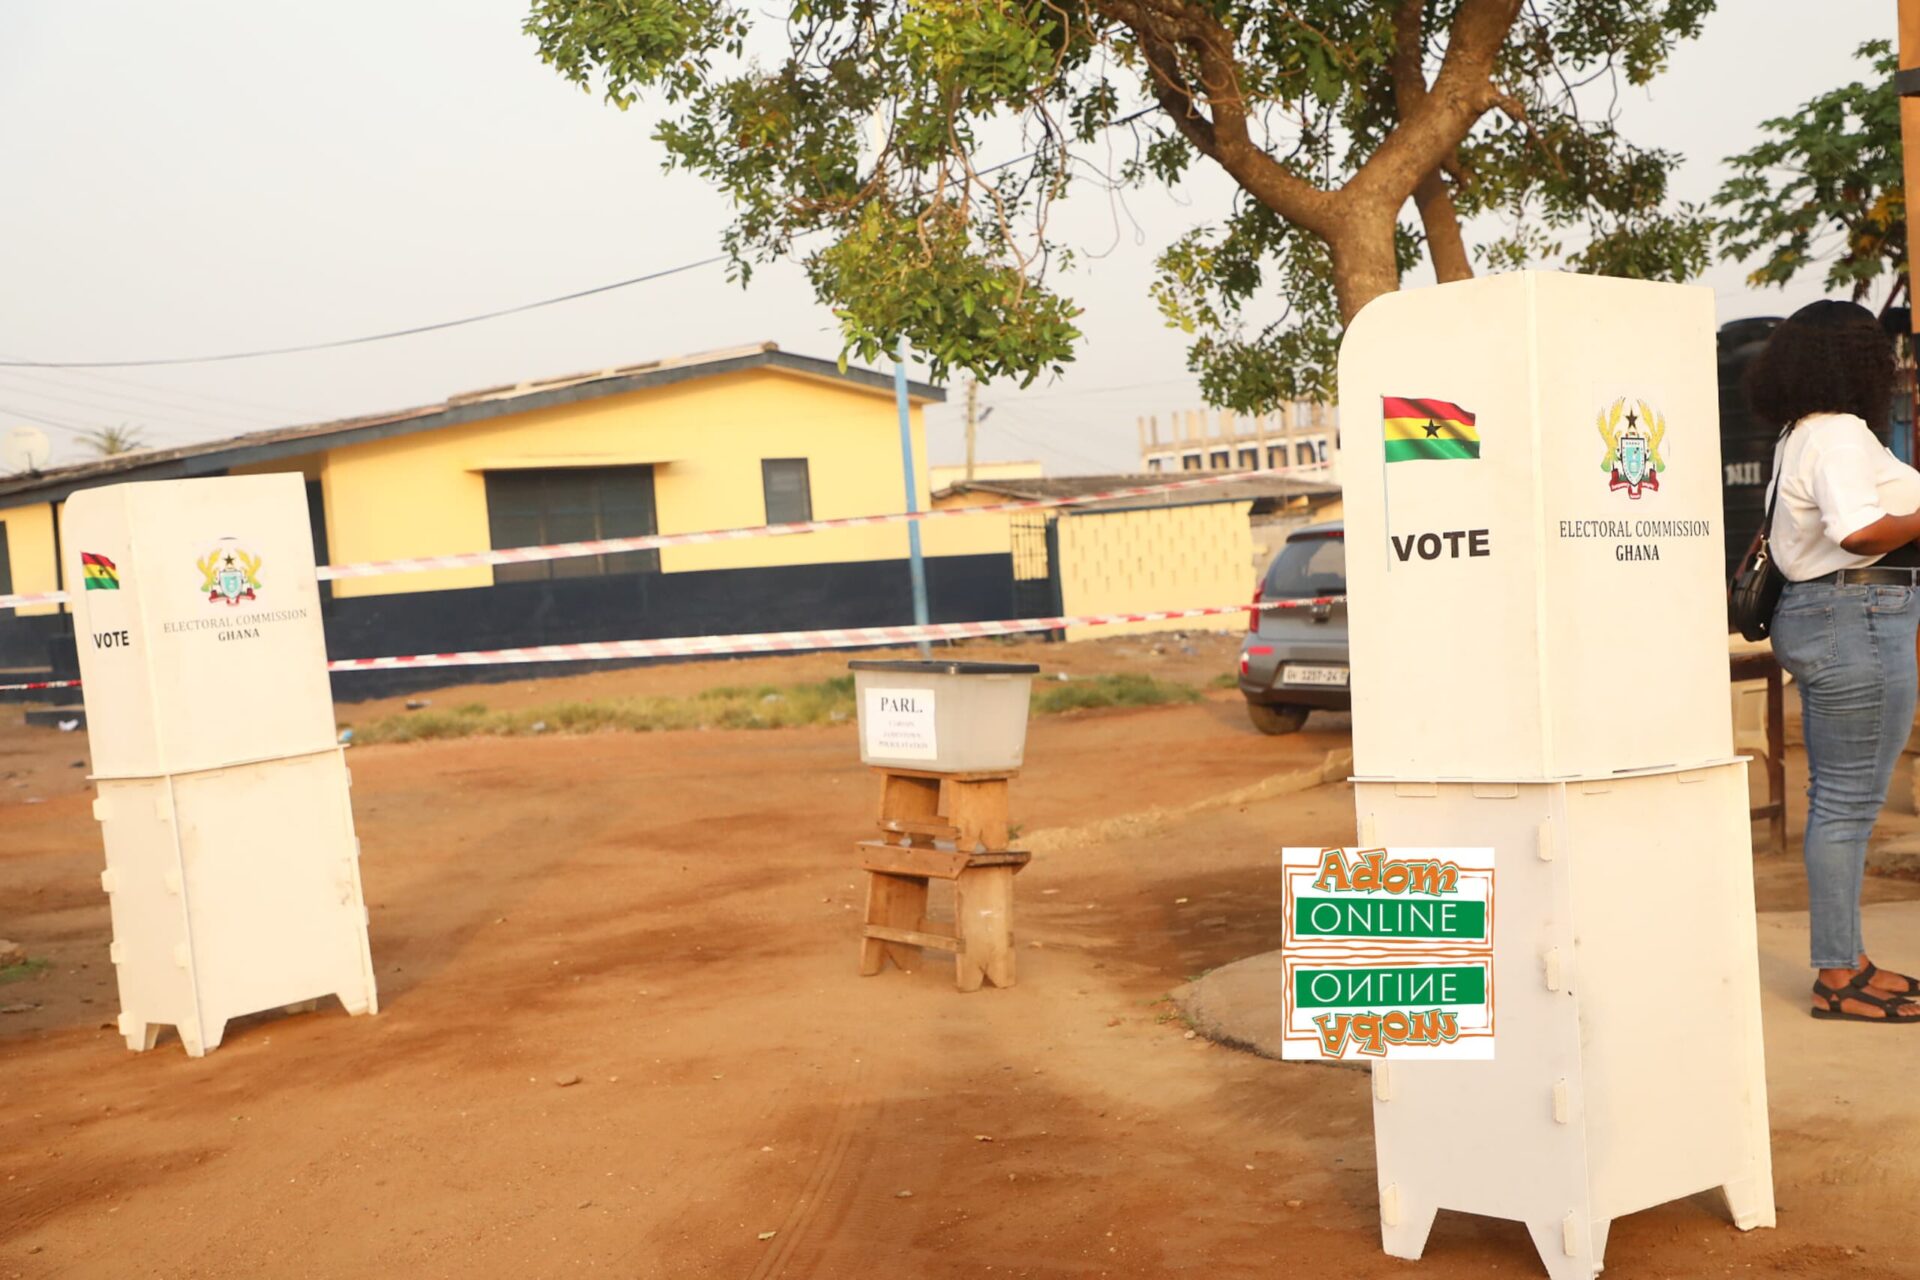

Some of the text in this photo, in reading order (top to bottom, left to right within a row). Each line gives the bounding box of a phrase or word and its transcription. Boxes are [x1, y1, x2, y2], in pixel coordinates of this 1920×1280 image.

[1559, 520, 1710, 538] ELECTORAL COMMISSION
[1391, 529, 1490, 562] VOTE
[1616, 544, 1660, 561] GHANA
[163, 608, 308, 633] ELECTORAL COMMISSION
[93, 630, 130, 649] VOTE
[218, 627, 260, 642] GHANA
[880, 696, 923, 713] PARL.
